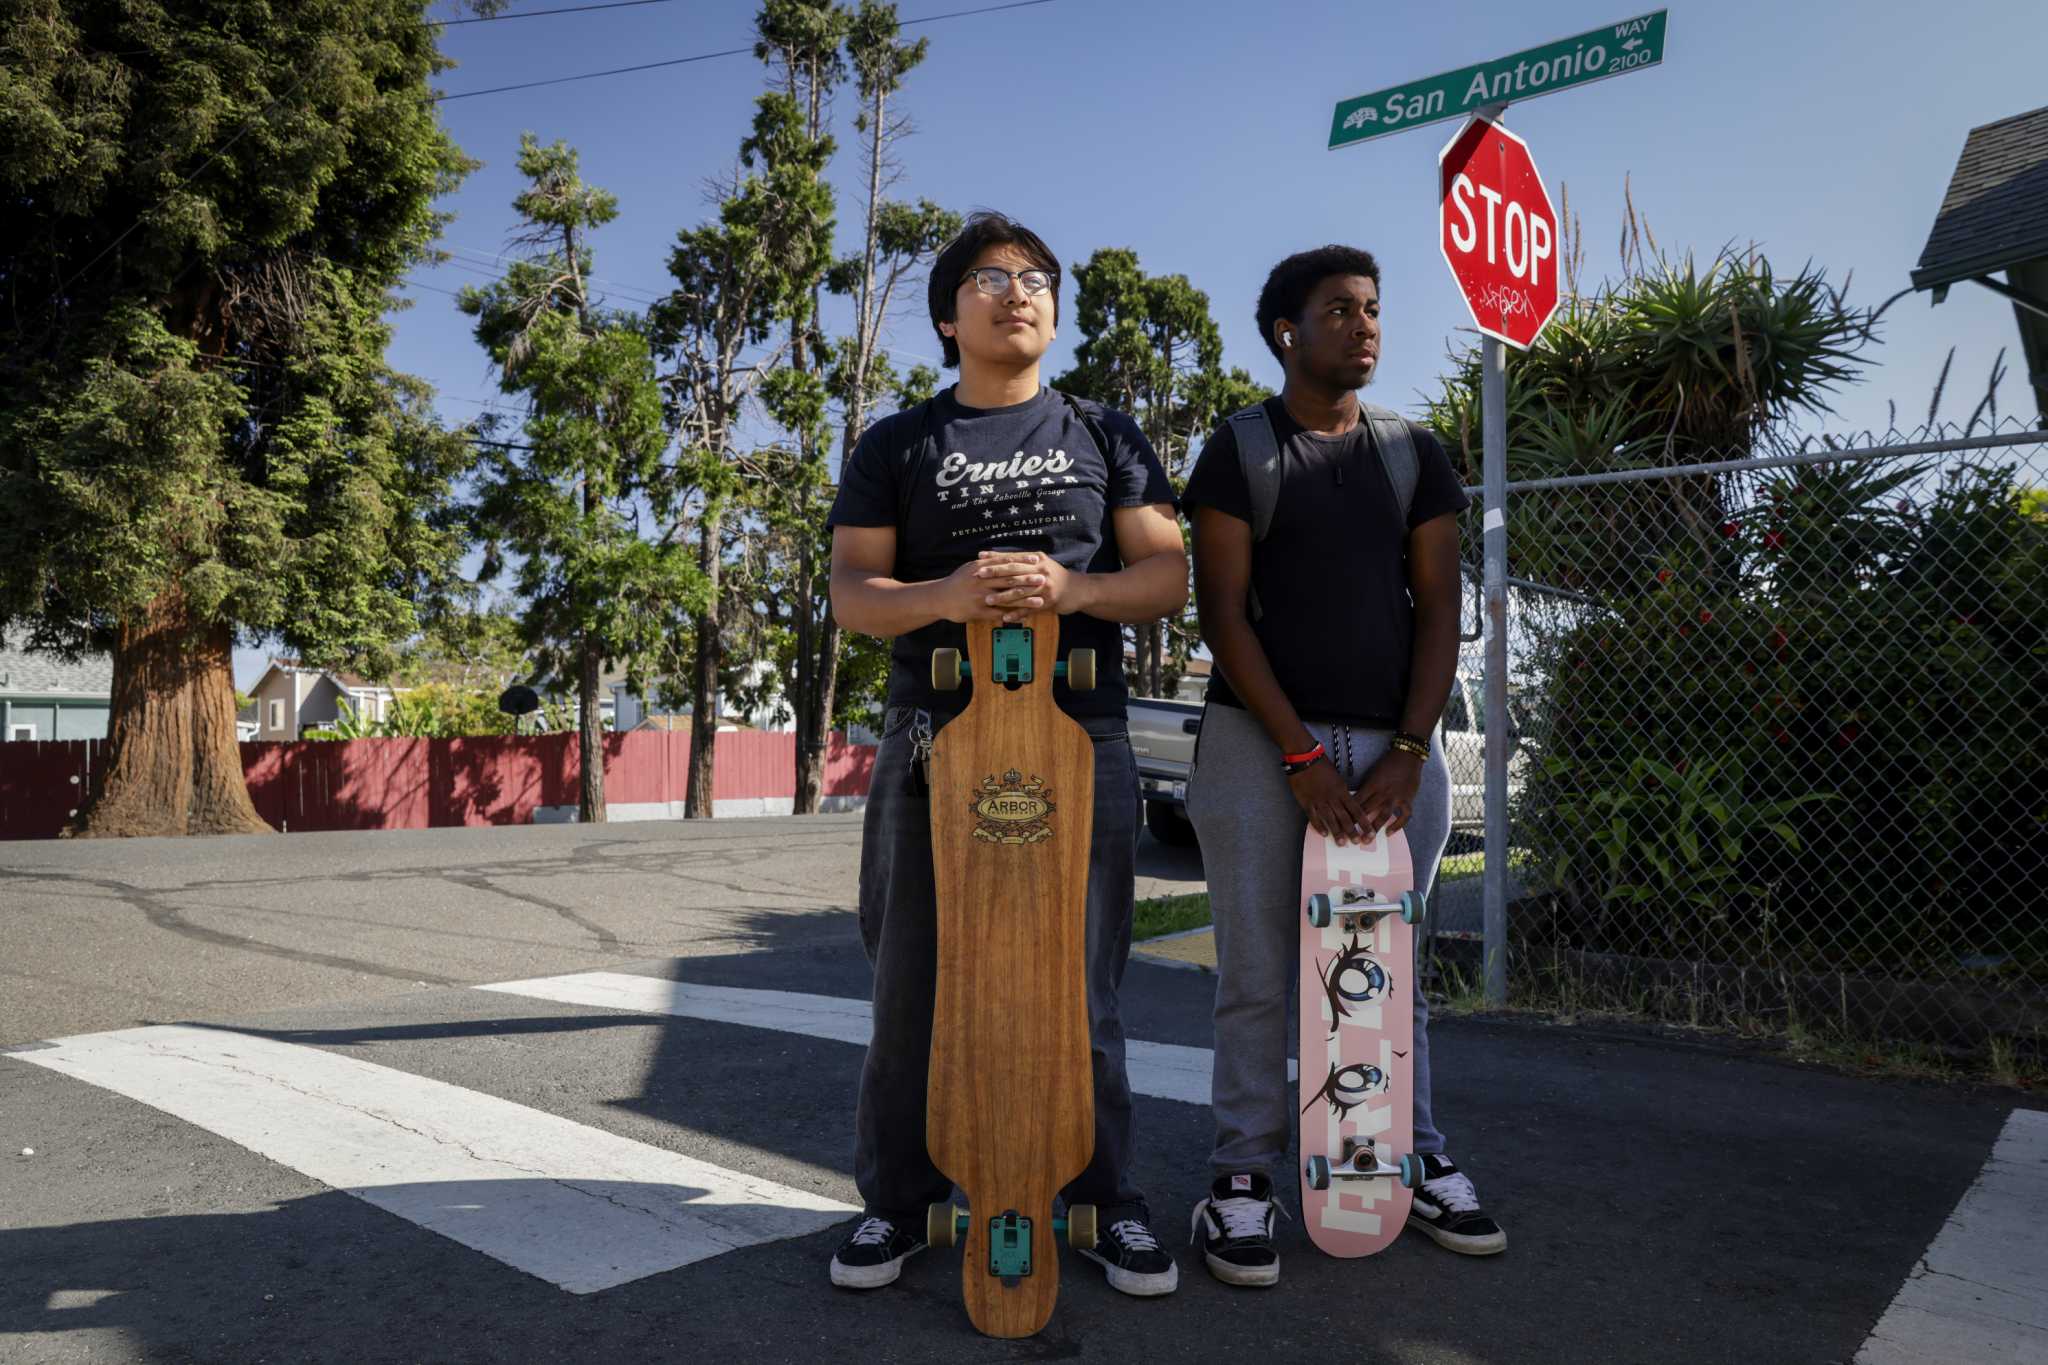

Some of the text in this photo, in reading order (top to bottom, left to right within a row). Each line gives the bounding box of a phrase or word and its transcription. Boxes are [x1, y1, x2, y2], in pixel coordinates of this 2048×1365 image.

[1615, 16, 1653, 39] WAY
[1608, 48, 1652, 74] 2100
[1382, 43, 1608, 125] San Antonio
[1450, 172, 1551, 286] STOP
[935, 448, 1075, 488] Ernie's
[937, 475, 1079, 502] TIN BAR
[951, 500, 968, 510] and
[1014, 513, 1077, 527] CALIFORNIA
[987, 799, 1038, 812] ARBOR
